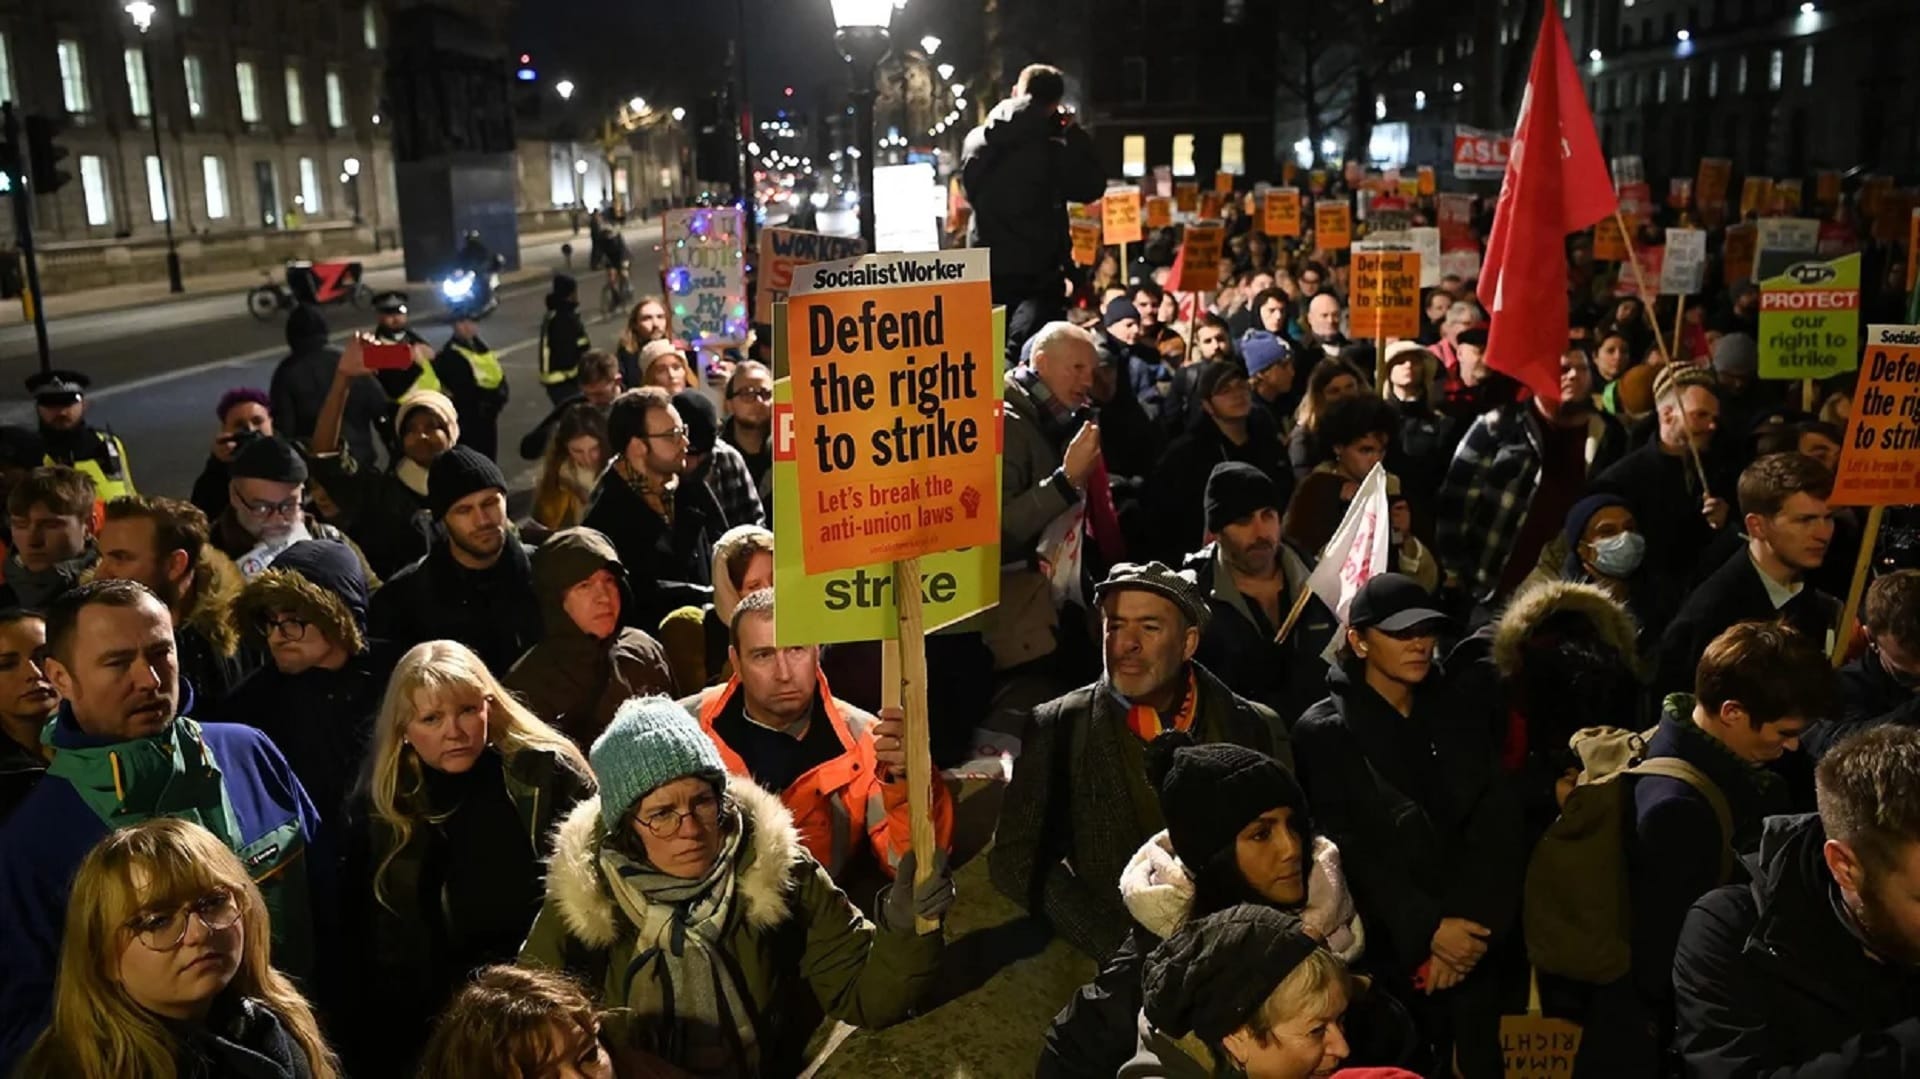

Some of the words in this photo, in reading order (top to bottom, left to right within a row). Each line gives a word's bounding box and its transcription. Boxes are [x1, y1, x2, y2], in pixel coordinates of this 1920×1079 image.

[813, 264, 897, 289] Socialist
[898, 259, 965, 282] Worker
[1761, 291, 1858, 309] PROTECT
[809, 295, 944, 356] Defend
[1791, 315, 1826, 329] our
[1769, 331, 1818, 350] right
[1826, 332, 1846, 348] to
[1779, 351, 1837, 367] strike
[810, 362, 875, 415] the
[890, 351, 976, 415] right
[1862, 386, 1895, 417] the
[814, 425, 856, 473] to
[871, 408, 978, 466] strike
[1854, 420, 1875, 450] to
[818, 486, 862, 514] Let's
[870, 478, 920, 506] break
[925, 475, 953, 497] the
[820, 511, 911, 543] anti-union
[918, 505, 954, 529] laws
[824, 569, 957, 611] stre
